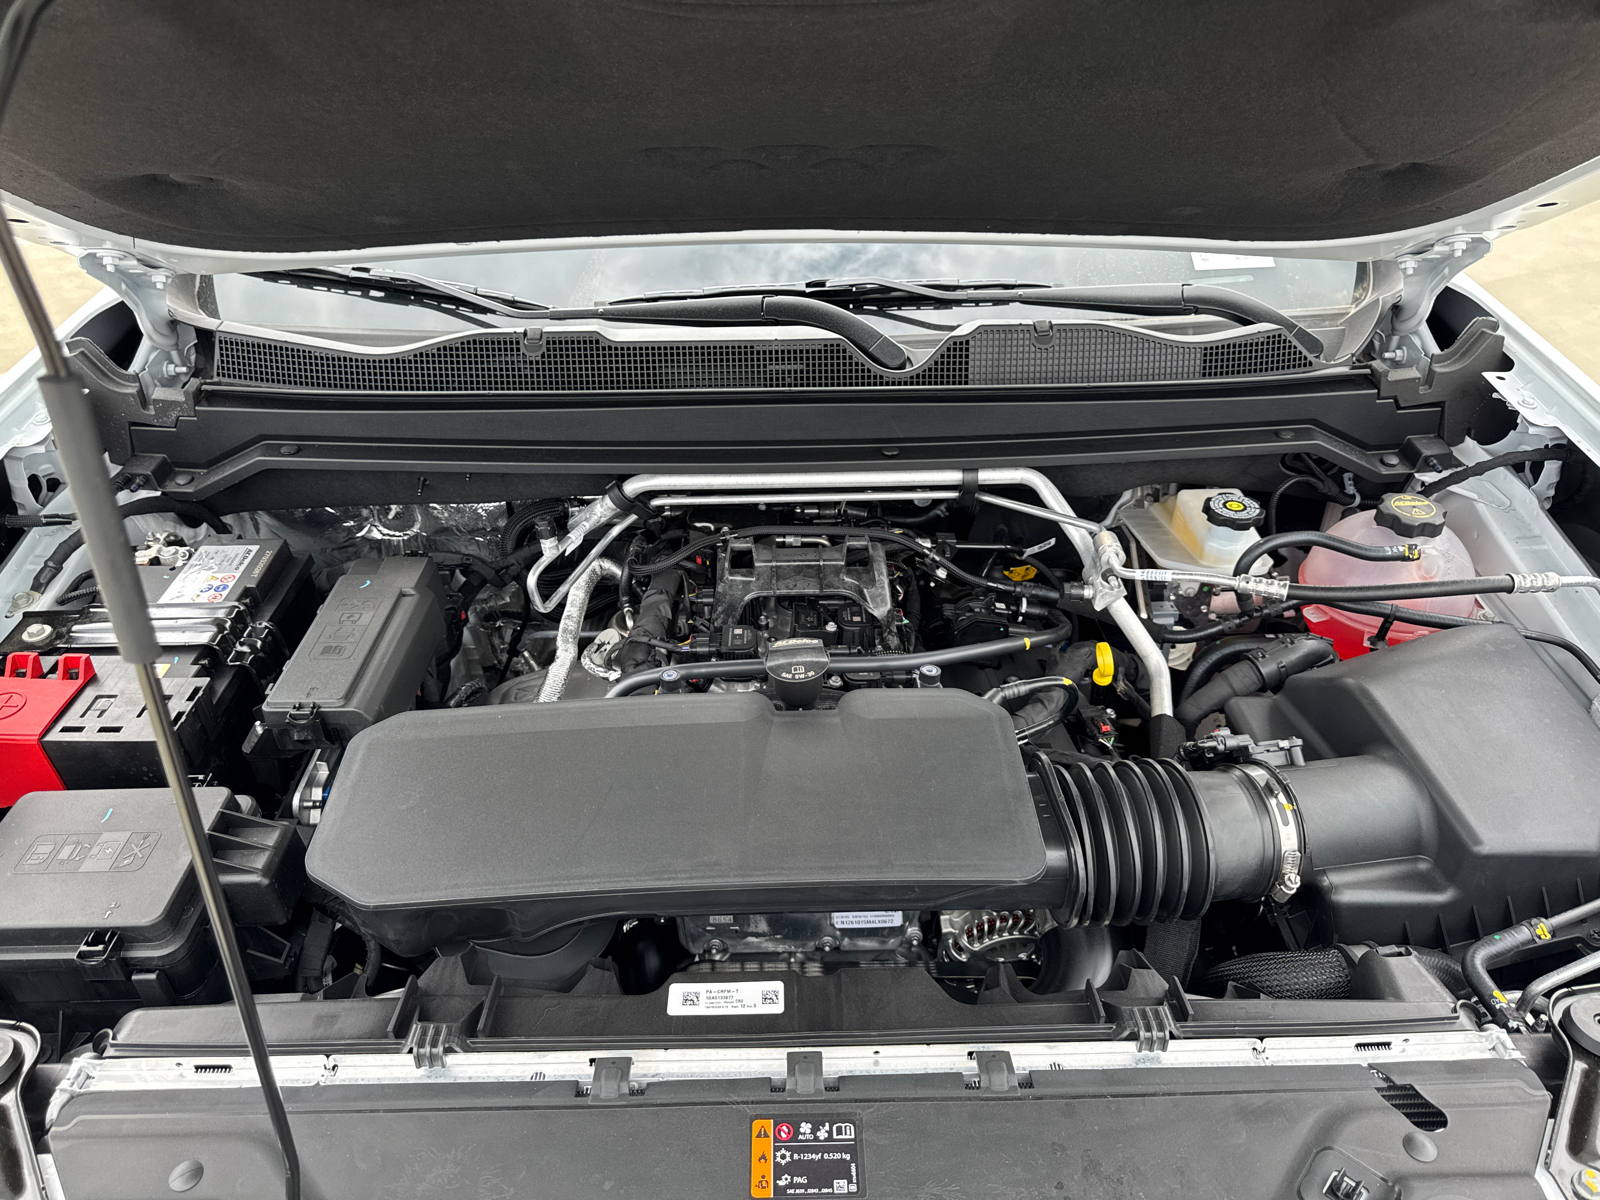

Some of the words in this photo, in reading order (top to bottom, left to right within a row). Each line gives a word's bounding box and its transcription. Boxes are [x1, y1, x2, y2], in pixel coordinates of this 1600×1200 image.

[793, 1152, 822, 1161] R-1234yf
[823, 1152, 841, 1160] 0.520
[842, 1152, 851, 1161] kg
[793, 1176, 808, 1184] PAG
